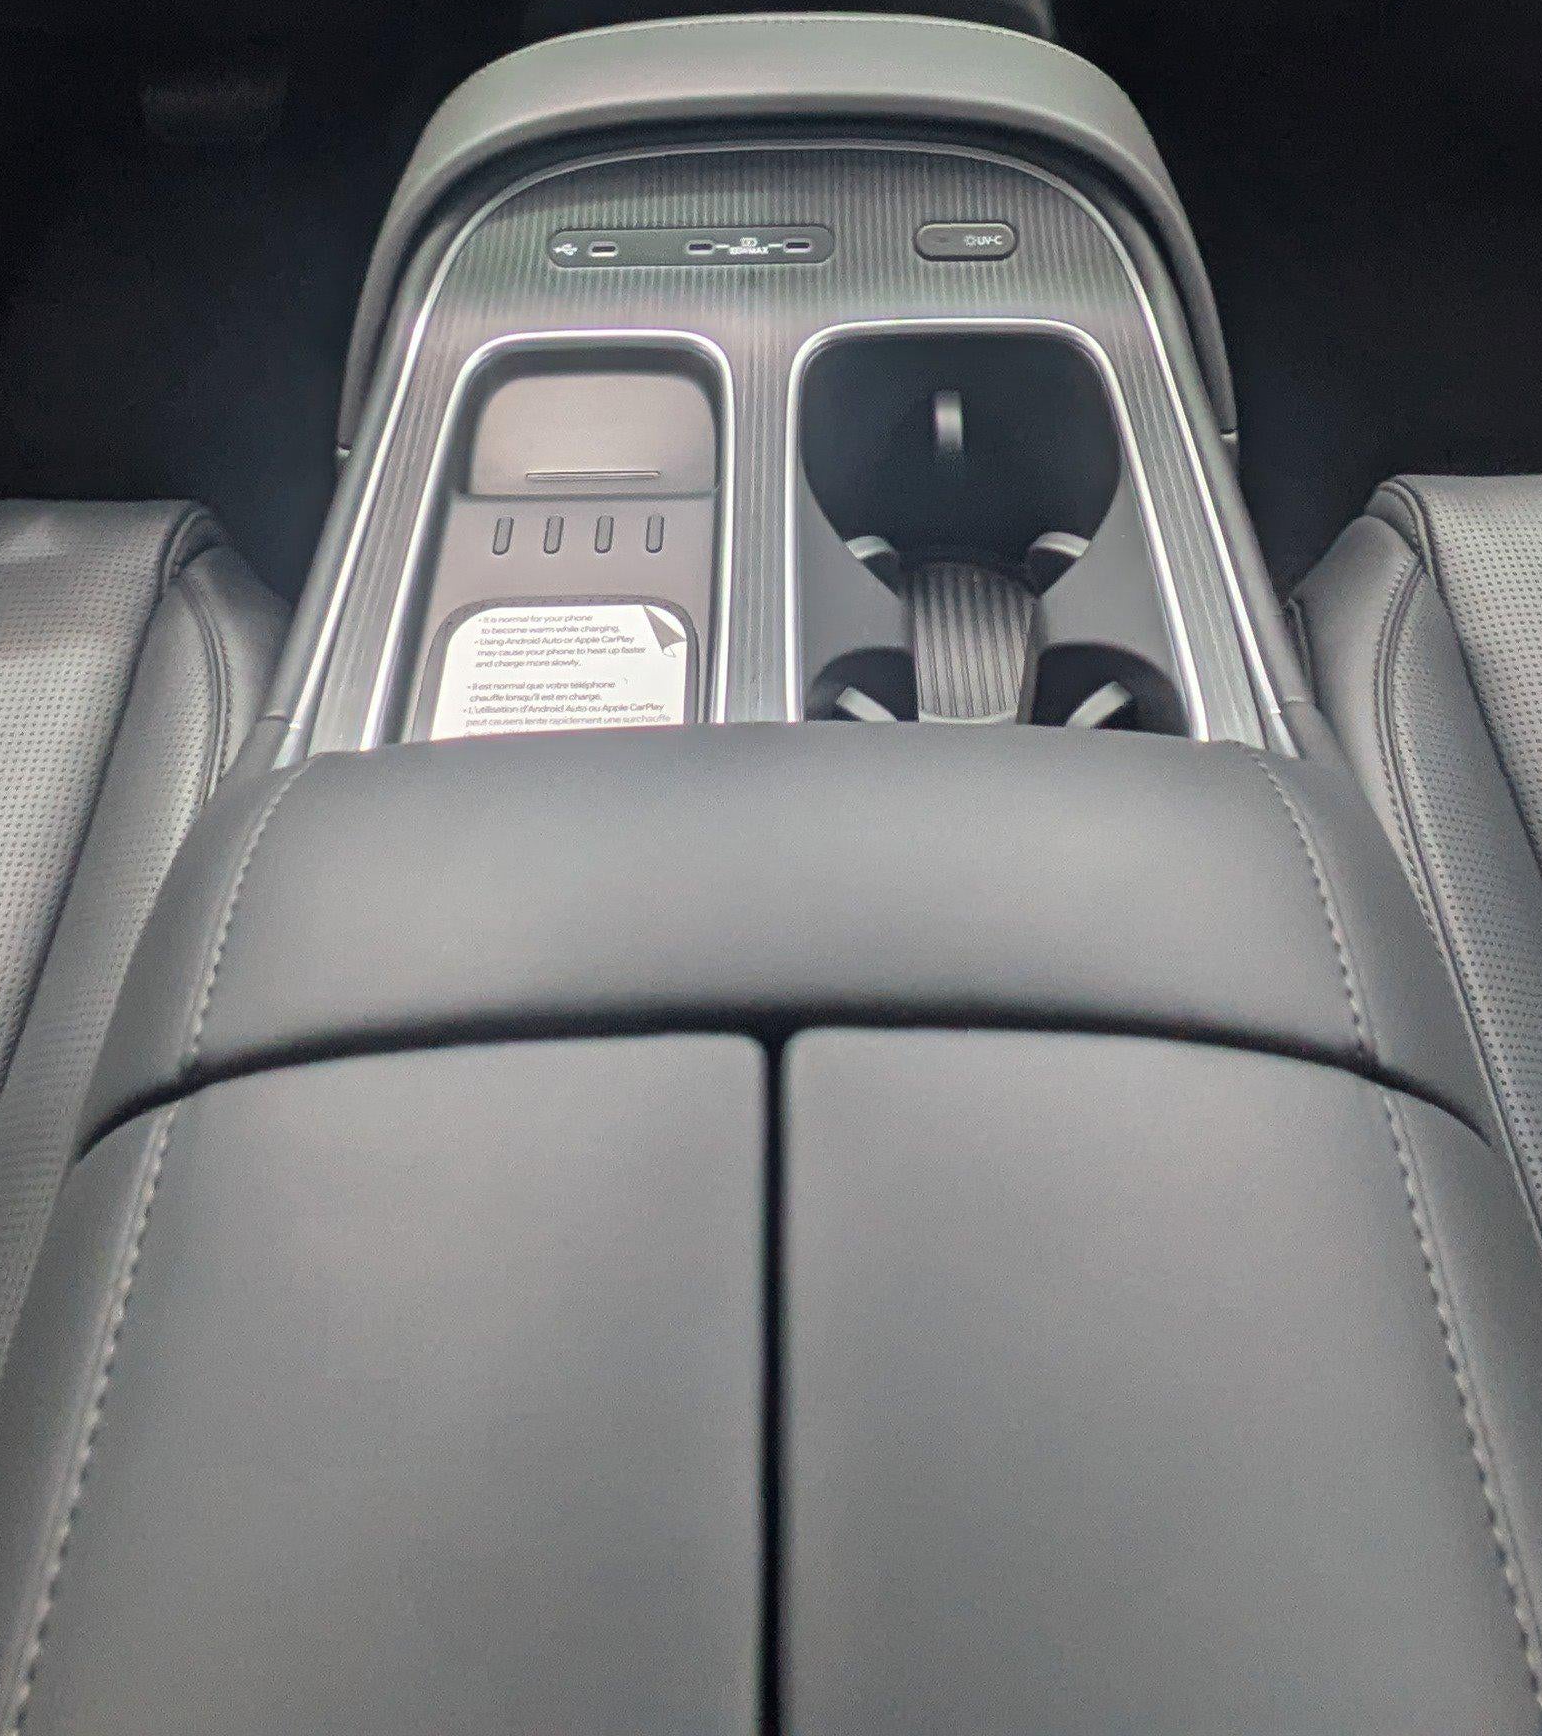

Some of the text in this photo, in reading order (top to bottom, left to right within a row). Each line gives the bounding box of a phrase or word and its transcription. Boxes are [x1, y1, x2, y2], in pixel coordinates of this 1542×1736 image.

[976, 235, 1003, 246] UV-C
[498, 615, 529, 624] normal
[565, 614, 593, 624] phone
[490, 627, 527, 635] become
[479, 637, 504, 647] Using
[505, 636, 541, 646] Android
[541, 636, 562, 645] Auto
[575, 635, 600, 646] Apple
[601, 634, 635, 646] CarPlay
[477, 649, 497, 658] may
[546, 647, 575, 657] phone
[494, 682, 526, 691] normal
[603, 704, 628, 714] Apple
[629, 702, 666, 714] CarPlay
